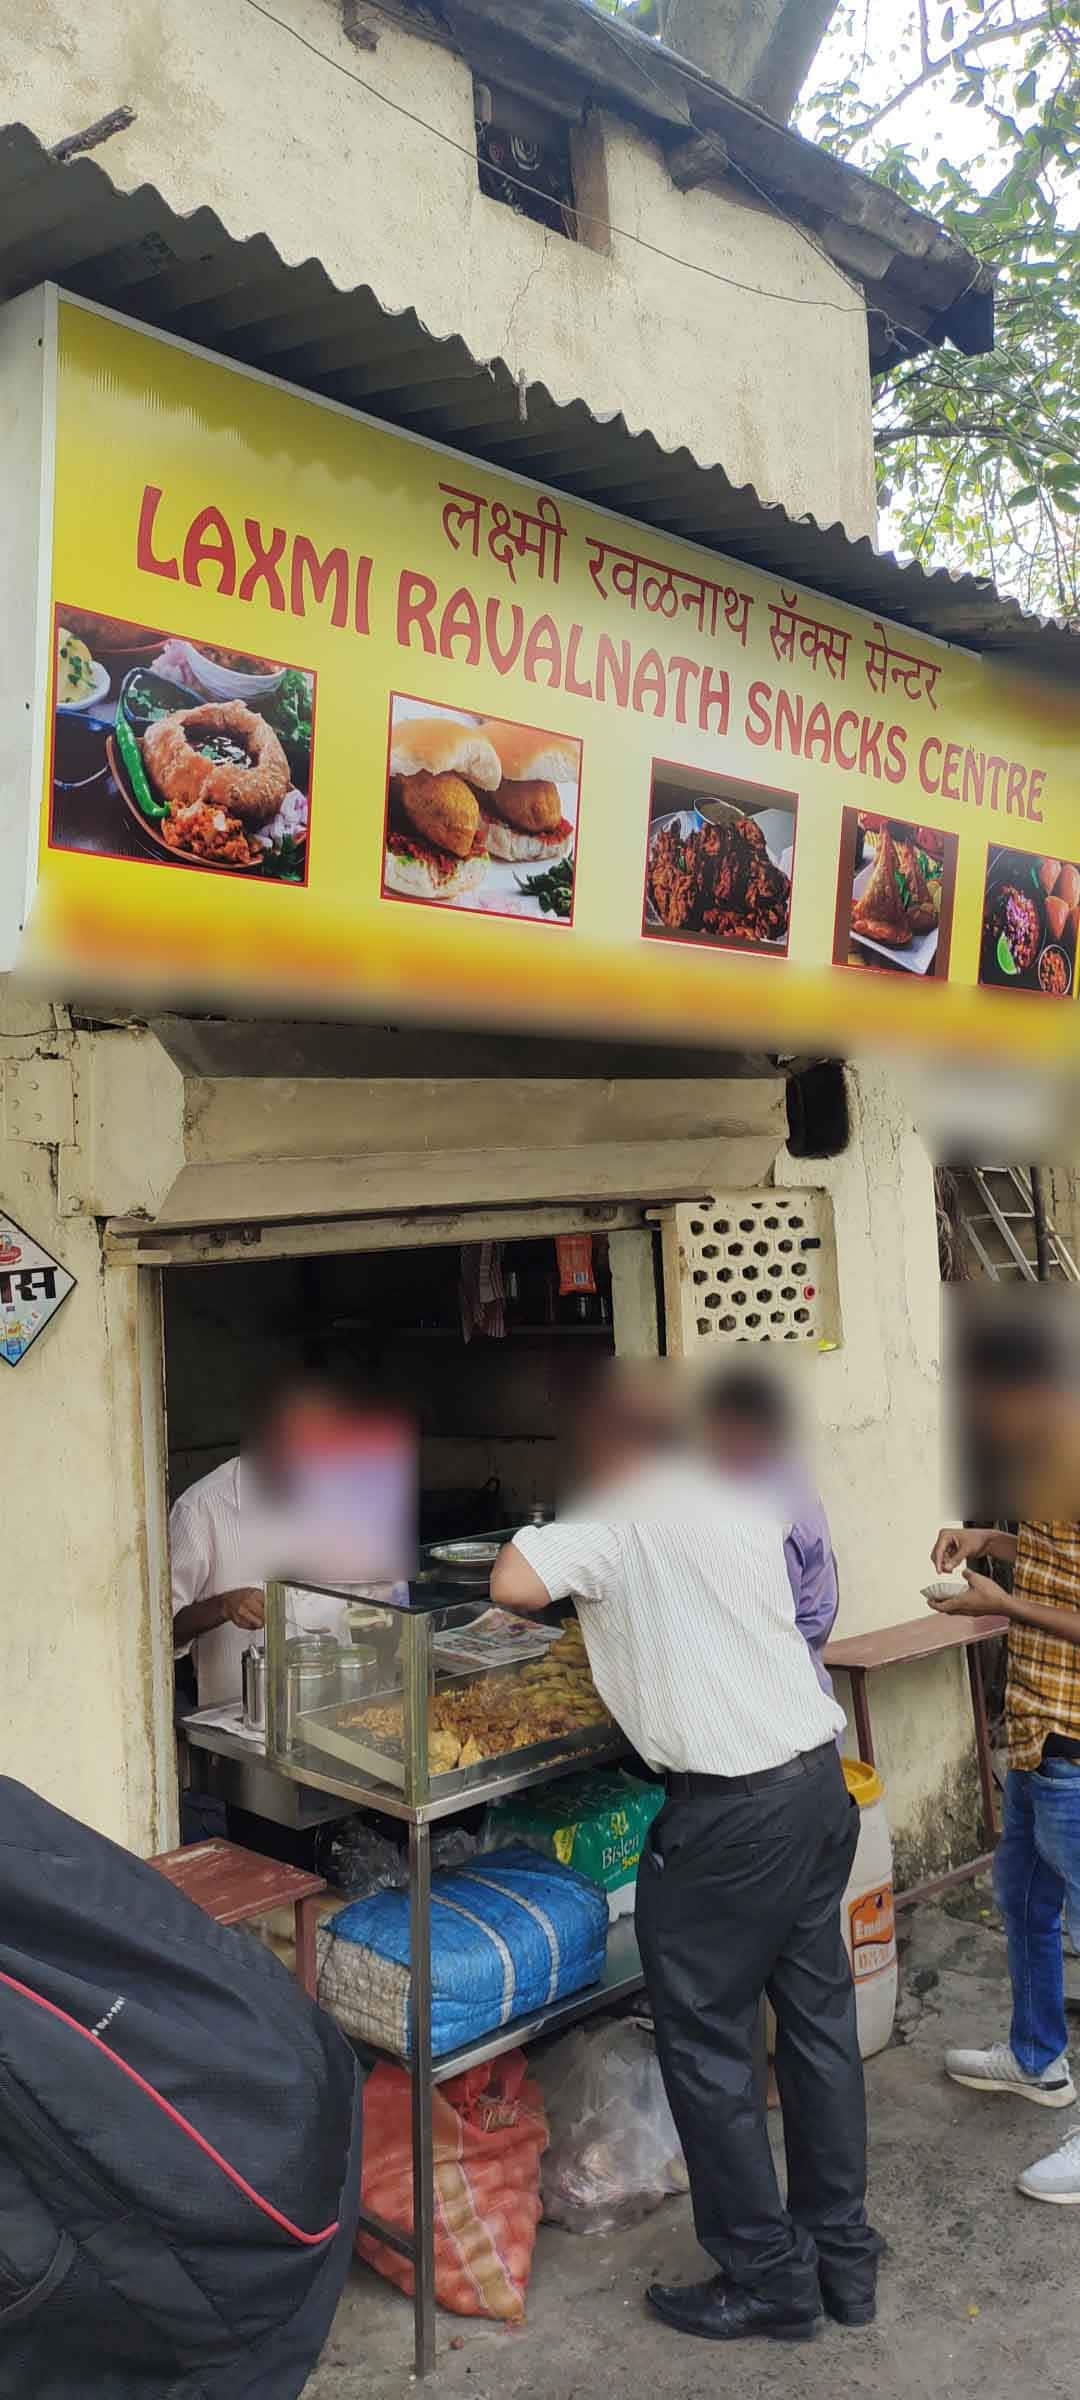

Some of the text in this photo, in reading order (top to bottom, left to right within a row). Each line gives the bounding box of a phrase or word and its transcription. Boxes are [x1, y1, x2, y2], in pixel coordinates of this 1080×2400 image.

[136, 485, 1047, 823] LAXMI RAVALNATH SNACKS CENTRE
[438, 482, 568, 584] लक्ष्मी
[585, 536, 754, 648] रवळनाथ
[864, 622, 942, 711] सेन्टर
